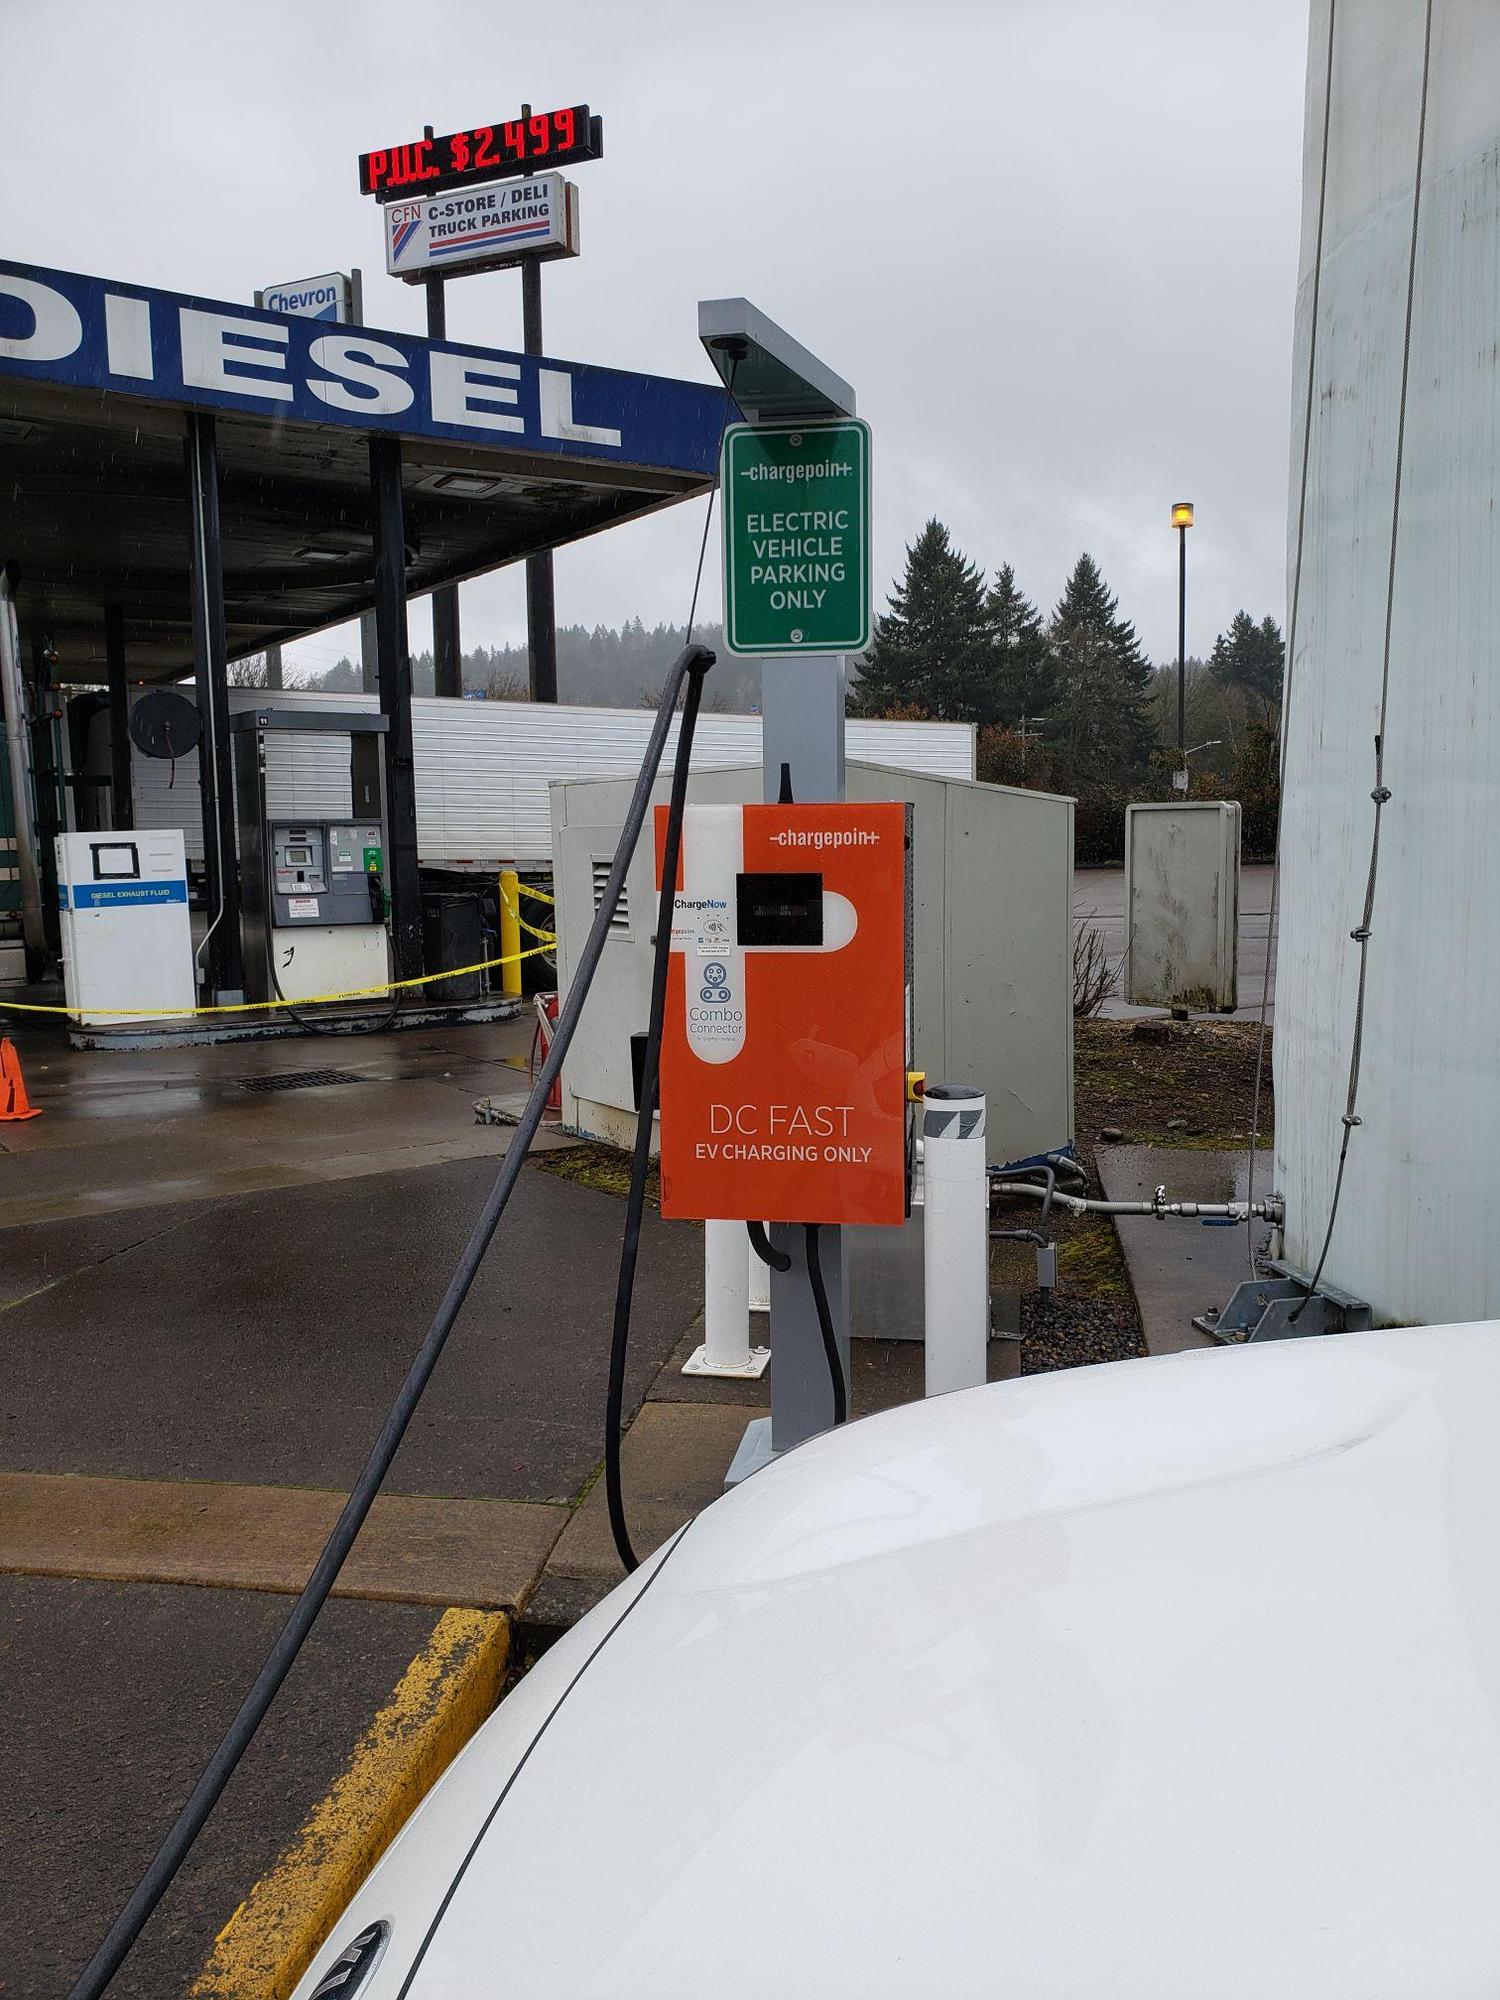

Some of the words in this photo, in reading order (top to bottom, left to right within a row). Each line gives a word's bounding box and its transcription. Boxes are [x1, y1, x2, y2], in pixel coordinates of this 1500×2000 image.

[450, 108, 575, 171] $2.499
[428, 191, 496, 220] C-STORE
[511, 183, 549, 205] DELI
[391, 204, 422, 224] CFN
[429, 214, 477, 238] TRUCK
[481, 203, 550, 228] PARKING
[268, 286, 337, 312] Chevron
[0, 274, 622, 447] DIESEL
[747, 510, 849, 533] ELECTRIC
[752, 537, 843, 559] VEHICLE
[751, 563, 846, 584] PARKING
[770, 589, 827, 610] ONLY
[117, 890, 149, 898] EXHAUST
[674, 899, 727, 911] ChargeNow
[690, 1007, 743, 1022] Combo
[690, 1023, 743, 1034] Connector
[710, 1104, 758, 1136] DC
[769, 1105, 855, 1137] FAST
[695, 1143, 719, 1160] EV
[722, 1144, 818, 1162] CHARGING
[823, 1146, 872, 1163] ONLY
